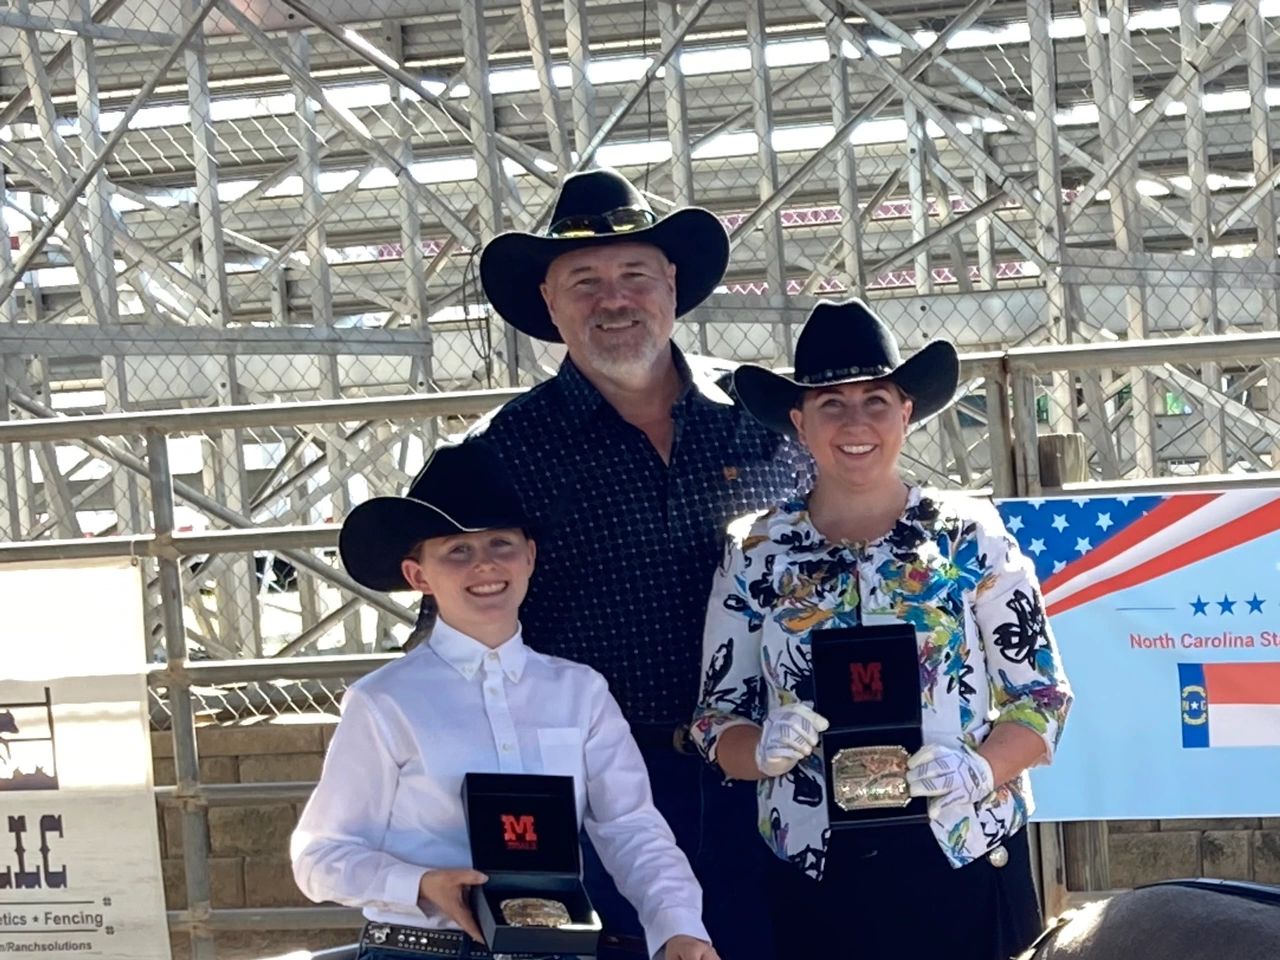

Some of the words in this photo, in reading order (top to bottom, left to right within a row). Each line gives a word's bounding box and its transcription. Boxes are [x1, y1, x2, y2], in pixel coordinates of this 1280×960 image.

[1130, 633, 1175, 649] North
[1181, 631, 1255, 648] Carolina
[501, 814, 537, 841] M
[44, 911, 104, 928] Fencing
